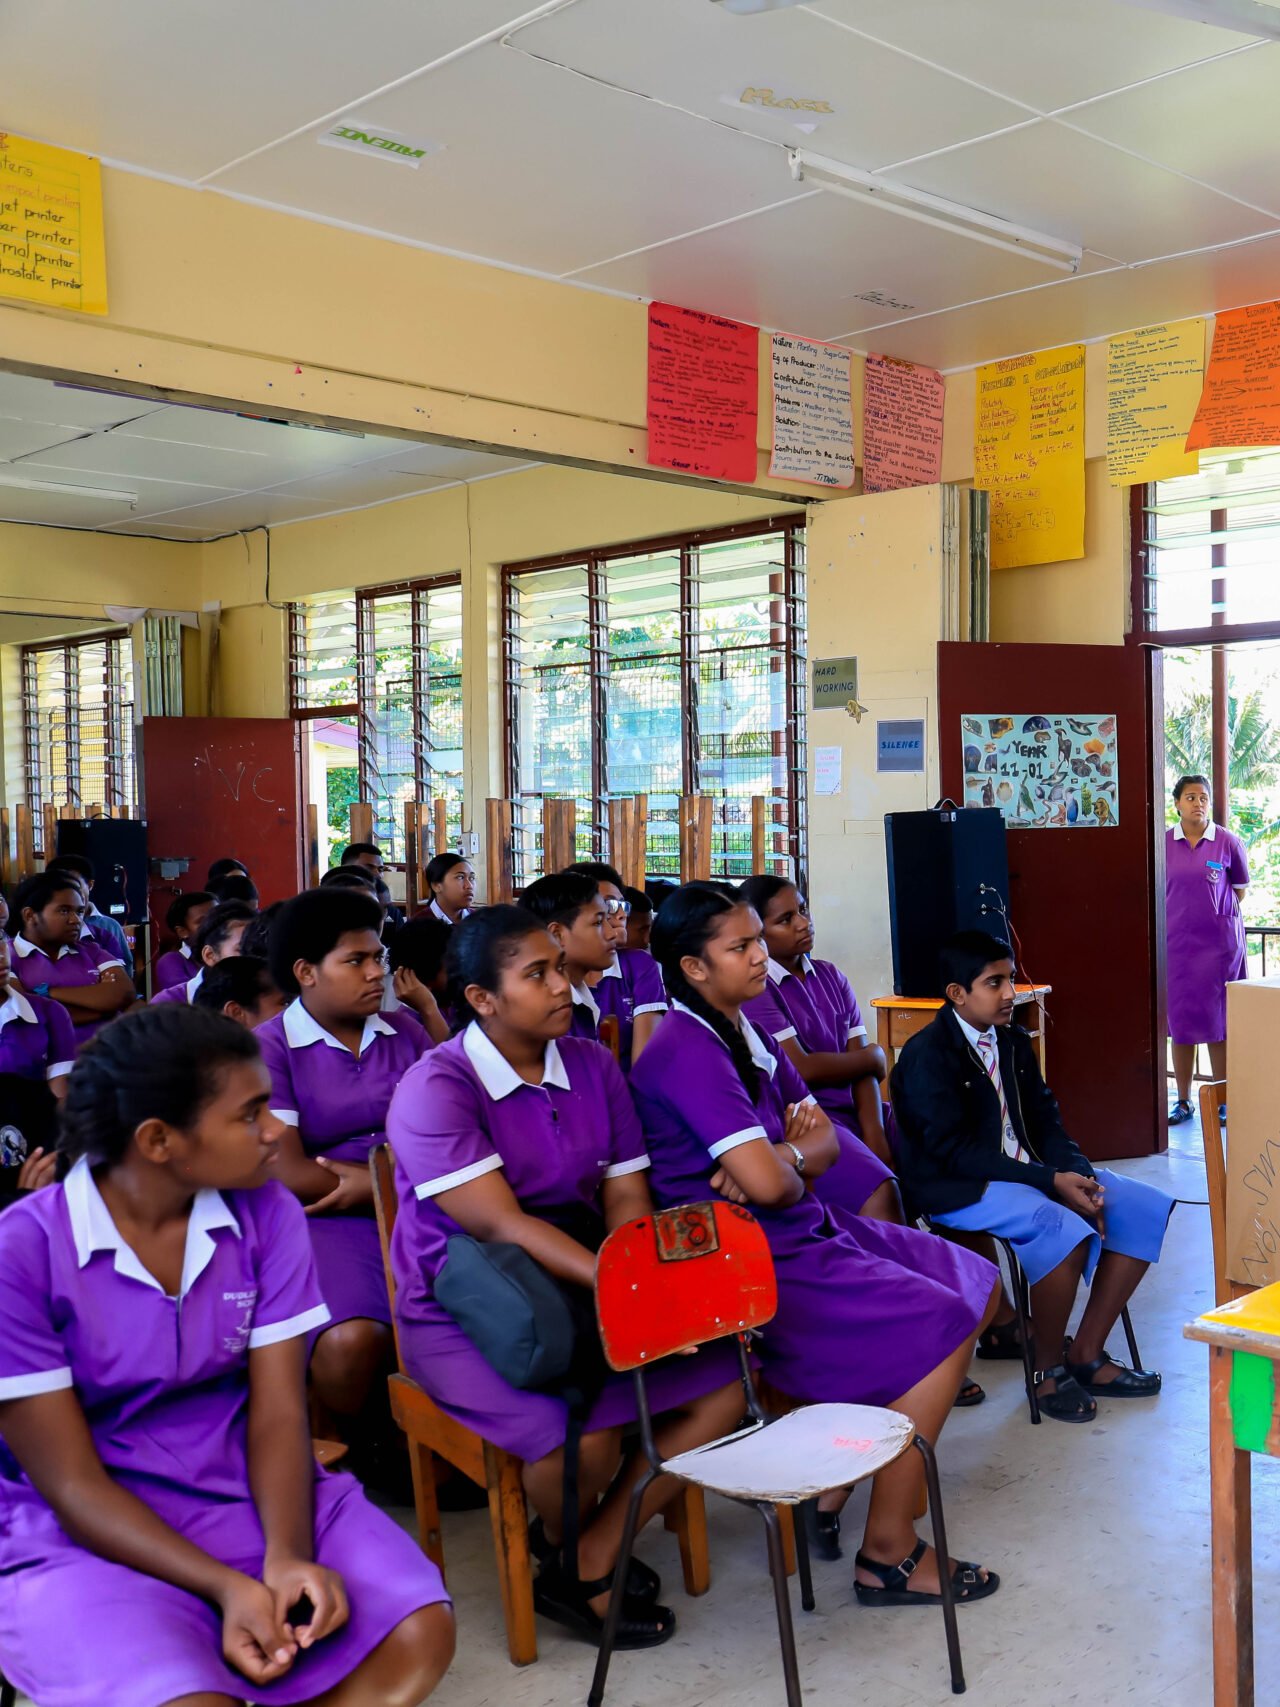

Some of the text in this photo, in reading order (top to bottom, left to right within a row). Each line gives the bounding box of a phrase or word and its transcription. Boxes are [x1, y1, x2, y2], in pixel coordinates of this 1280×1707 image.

[25, 208, 65, 224] printer
[26, 229, 75, 247] printer
[35, 251, 75, 268] printer
[775, 444, 812, 456] Contribution
[815, 667, 837, 677] HARD
[816, 682, 854, 693] WORKING
[881, 740, 920, 749] SILENCE
[1012, 740, 1048, 759] YEAR
